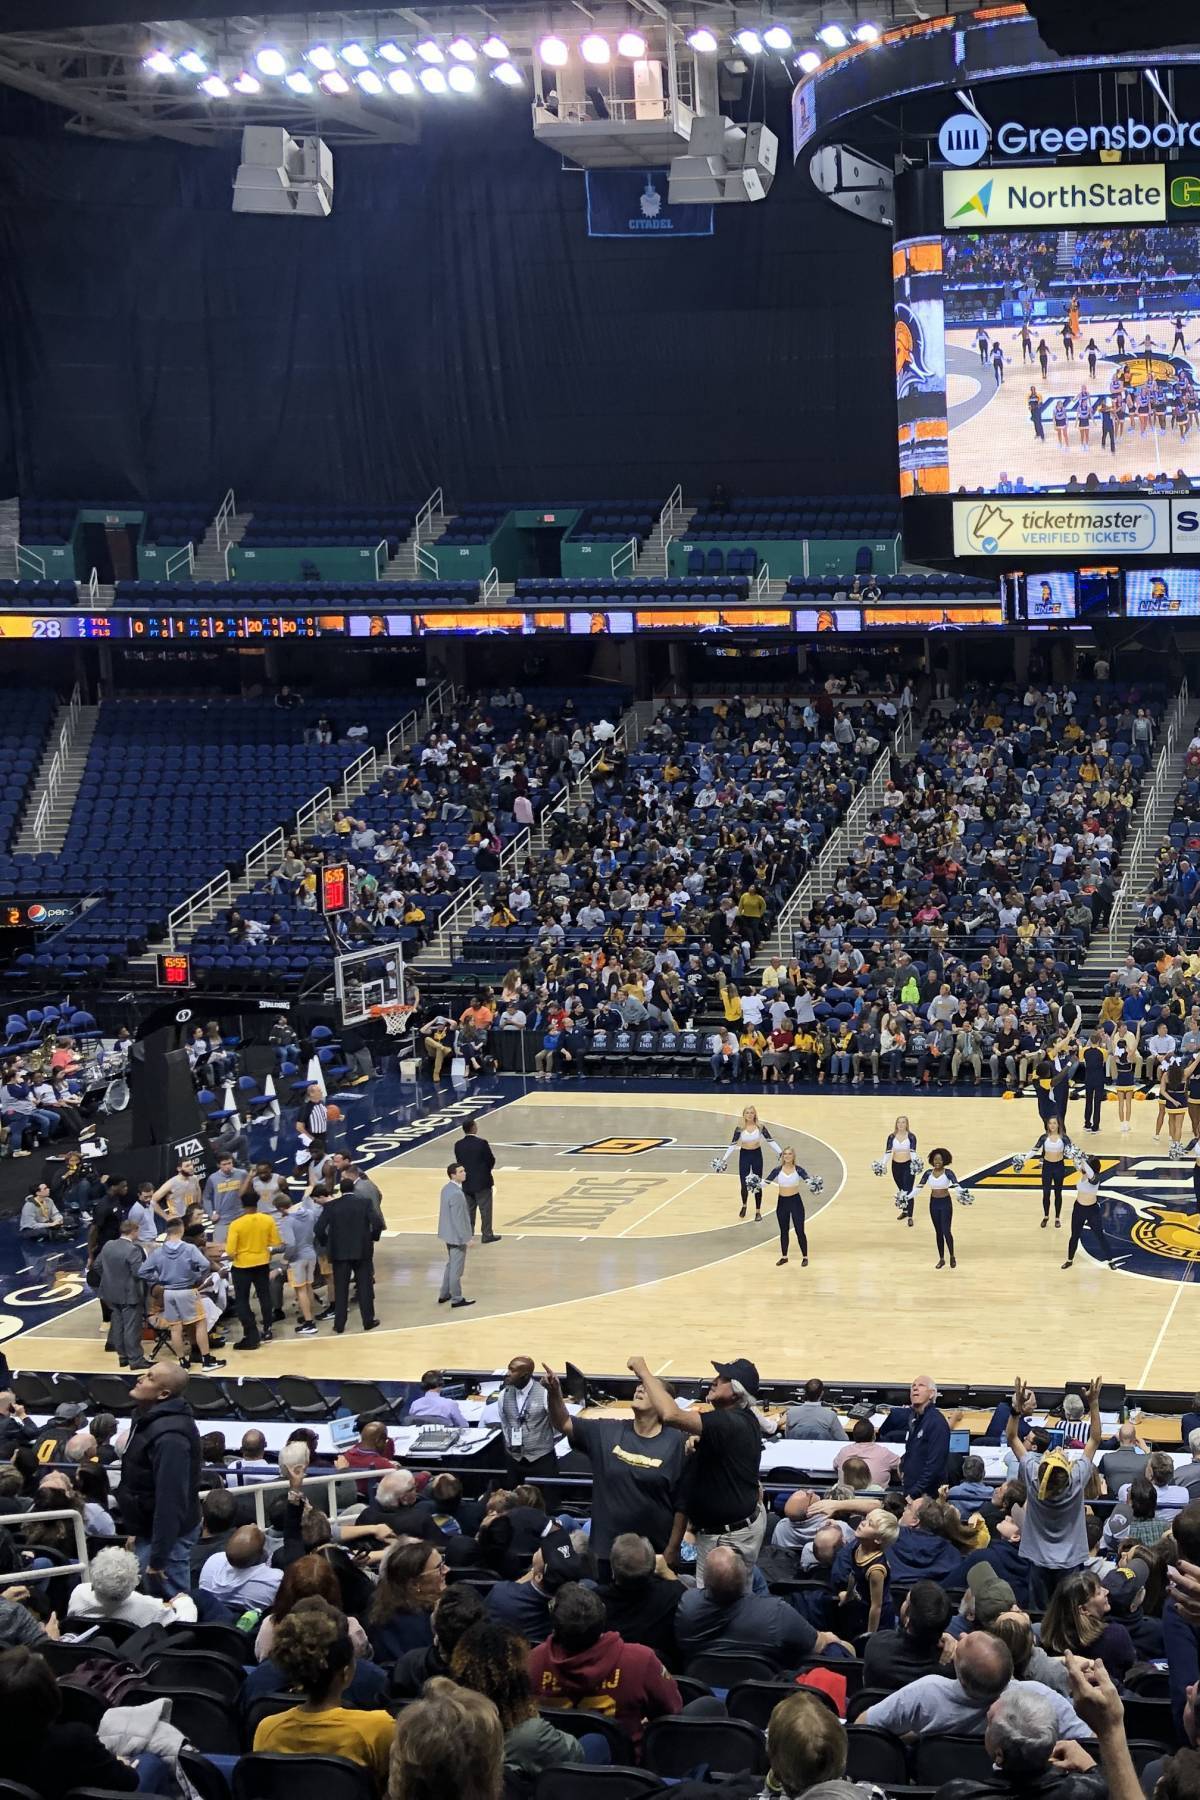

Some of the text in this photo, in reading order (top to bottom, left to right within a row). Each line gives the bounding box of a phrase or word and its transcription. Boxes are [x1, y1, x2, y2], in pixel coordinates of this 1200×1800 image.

[1008, 182, 1161, 211] NorthState
[628, 218, 674, 230] CITADEL
[1021, 510, 1142, 531] ticketmaster
[1022, 531, 1137, 544] VERIFIED TICKETS
[1034, 603, 1061, 614] UNCG
[1138, 600, 1182, 612] UNCG
[32, 619, 61, 638] 28
[78, 617, 110, 627] 2 TOL
[176, 621, 184, 633] 1
[215, 621, 224, 633] 2
[248, 620, 263, 633] 20
[79, 628, 110, 637] 2 FLS
[325, 868, 345, 883] 15:55
[325, 883, 344, 909] 30
[164, 957, 187, 968] 15:55
[166, 968, 185, 982] 30
[258, 1000, 291, 1010] SPALDING
[174, 1139, 204, 1157] TFA
[36, 1439, 56, 1463] 0
